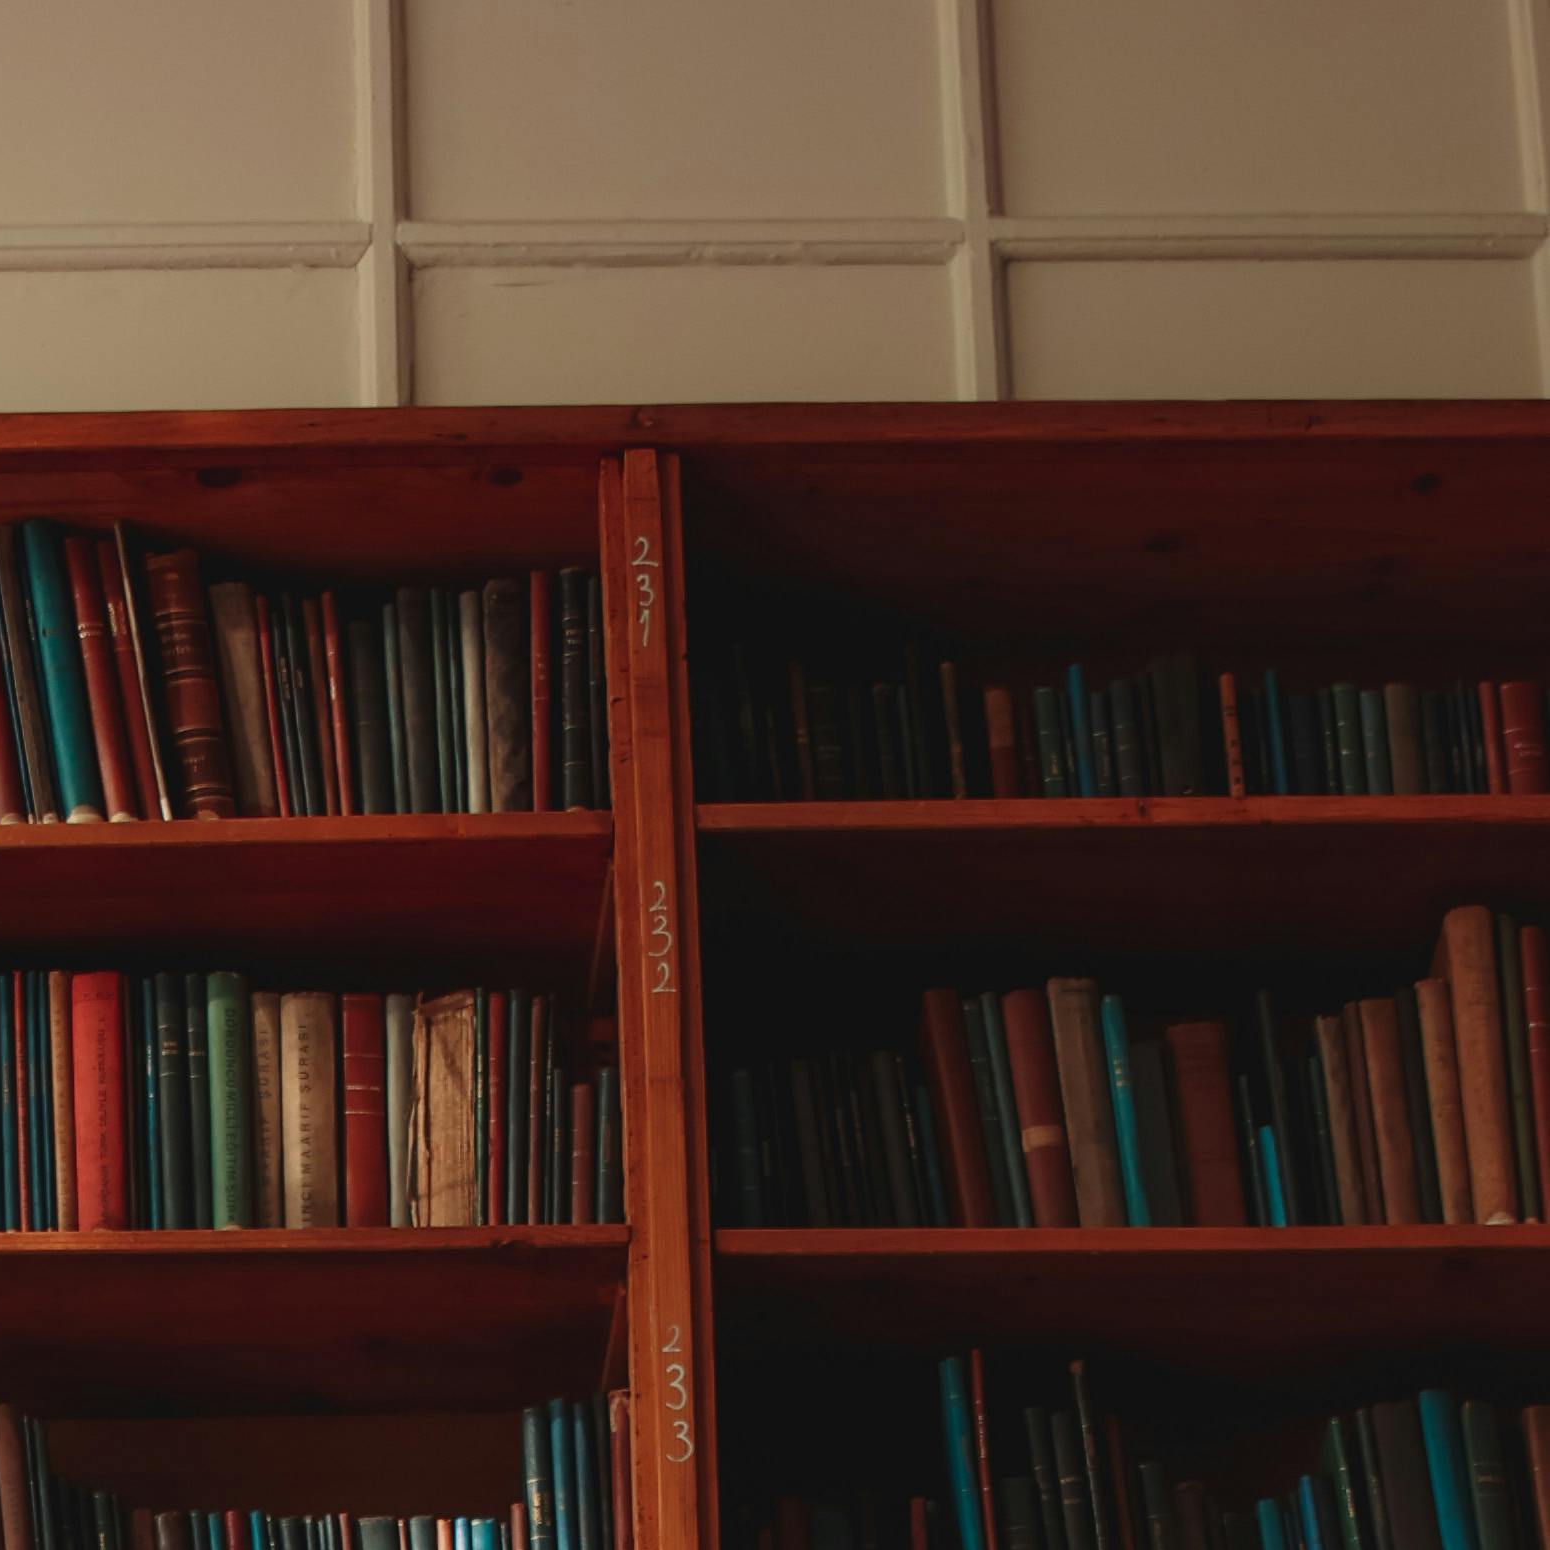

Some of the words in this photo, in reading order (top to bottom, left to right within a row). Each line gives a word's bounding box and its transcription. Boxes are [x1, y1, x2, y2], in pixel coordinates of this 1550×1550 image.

[631, 536, 659, 648] 231
[648, 880, 677, 993] 232
[662, 1325, 695, 1462] 233
